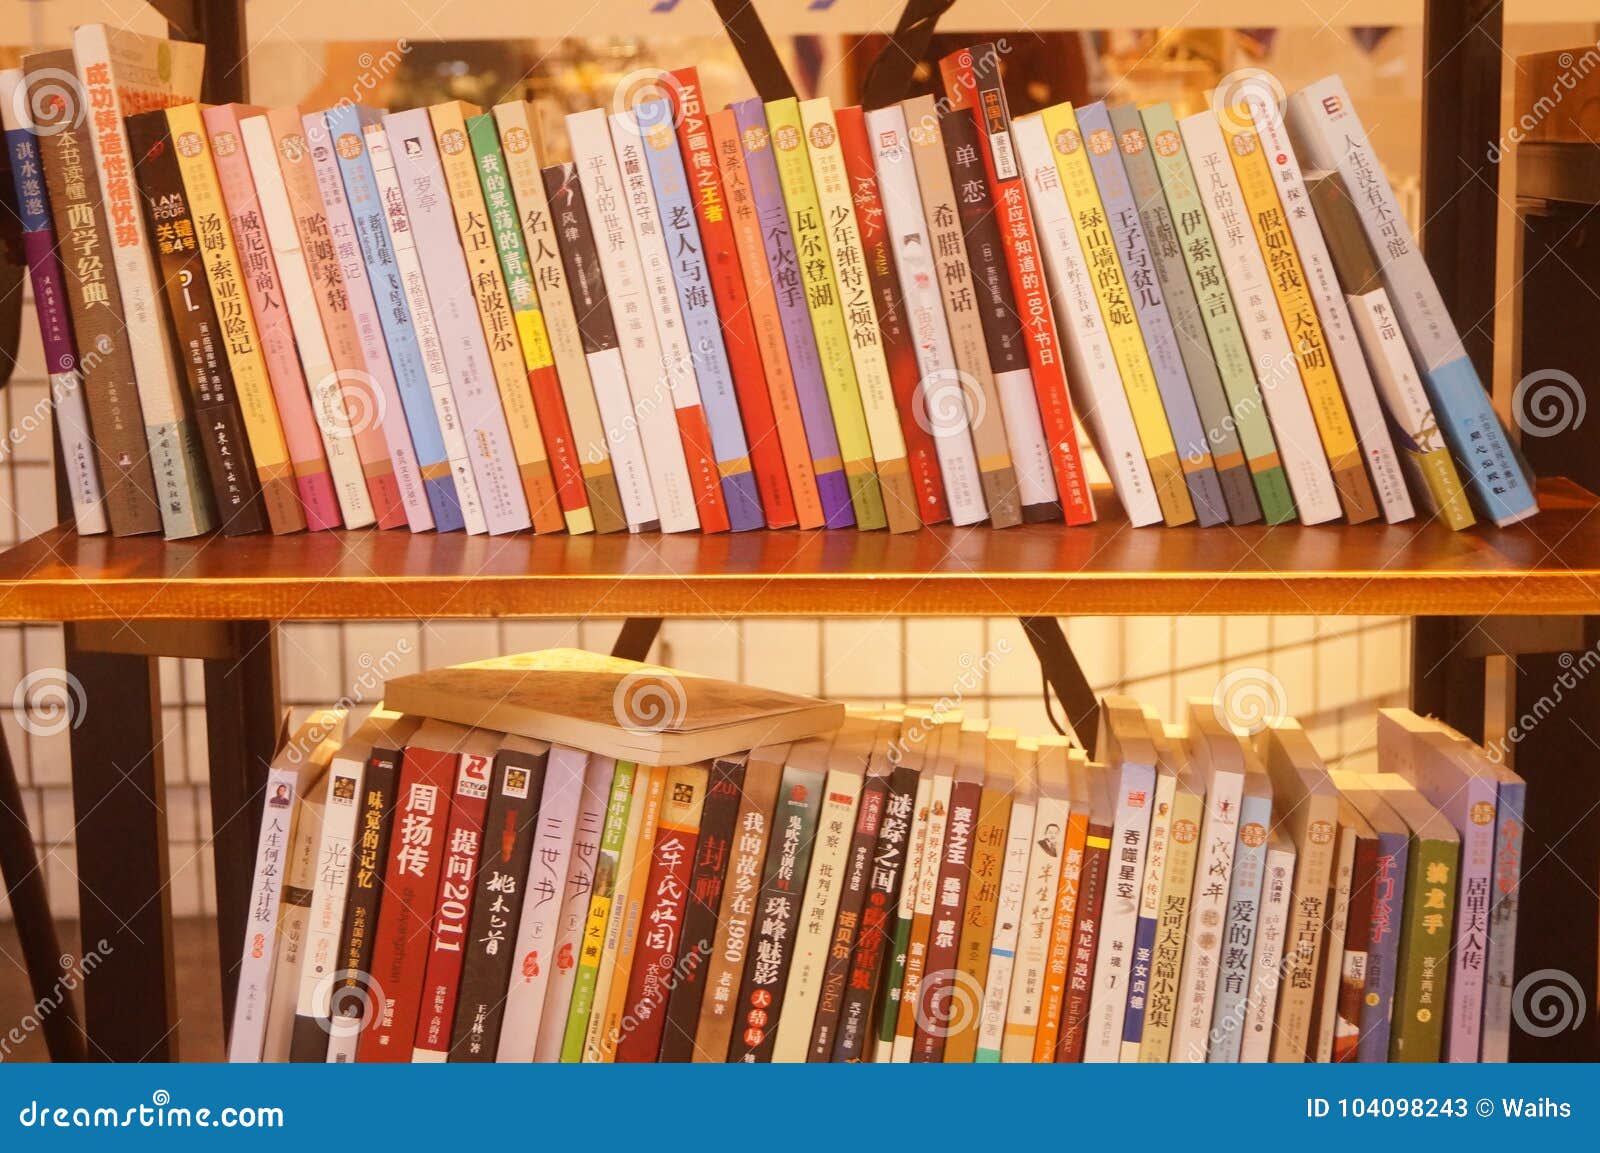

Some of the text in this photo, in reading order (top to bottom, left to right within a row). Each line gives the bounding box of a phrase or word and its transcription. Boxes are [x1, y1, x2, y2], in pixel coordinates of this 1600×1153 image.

[85, 63, 140, 247] 成功铸造性格优势
[679, 84, 724, 223] NBA画传之王者
[985, 93, 1004, 133] 中国人
[385, 187, 408, 233] 在藏地
[586, 155, 625, 251] 平凡的世界
[955, 144, 986, 203] 单恋
[1034, 165, 1058, 193] 信
[1200, 152, 1245, 248] 平凡的世界
[1344, 134, 1408, 259] 人生没有不可能
[239, 211, 280, 312] 威尼斯商人
[307, 213, 348, 313] 哈姆莱特
[481, 154, 532, 302] 我的晃荡的青春
[525, 210, 560, 291] 名人传
[669, 206, 708, 310] 老人与海
[759, 206, 803, 308] 三个火枪手
[793, 206, 833, 309] 瓦尔登湖
[830, 205, 877, 348] 少年维特之烦恼
[933, 203, 972, 313] 希腊神话
[1003, 187, 1054, 365] 你应该知道的180个节日
[1079, 208, 1133, 327] 绿山墙的安妮
[1112, 207, 1161, 310] 王子与贫儿
[1181, 210, 1228, 318] 伊索寓言
[199, 213, 252, 354] 汤姆·索亚历险记
[462, 211, 513, 352] 大卫·科波菲尔
[1257, 208, 1326, 370] 假如给我三天光明
[254, 817, 284, 922] 人生何必太计较
[321, 844, 348, 889] 光年
[357, 791, 384, 888] 味觉的记忆
[397, 783, 438, 878] 周扬传
[778, 815, 801, 880] 鬼吹灯前传
[870, 794, 913, 893] 谜踪之国
[921, 824, 941, 905] 世界名人传记
[947, 807, 972, 865] 资本之王
[1116, 829, 1140, 899] 吞噬星空
[1144, 827, 1165, 909] 世界名人传记
[434, 828, 478, 952] 提问2011
[479, 871, 516, 955] 桃木匕首
[645, 838, 685, 953] 牟氏庄园
[724, 812, 764, 962] 我的故乡在1980
[832, 911, 857, 960] 诺贝尔
[1051, 849, 1081, 974] 新编入党培训问答
[1462, 877, 1487, 970] 居里夫人传
[752, 897, 791, 985] 珠峰魅影
[904, 942, 925, 1002] 富兰克林
[1130, 947, 1149, 1010] 圣女贞德
[1149, 895, 1187, 1028] 契诃夫短篇小说集
[1225, 900, 1254, 994] 爱的教育
[1292, 897, 1322, 989] 堂吉诃德
[745, 991, 770, 1045] 大结局
[822, 972, 842, 1013] Nobel
